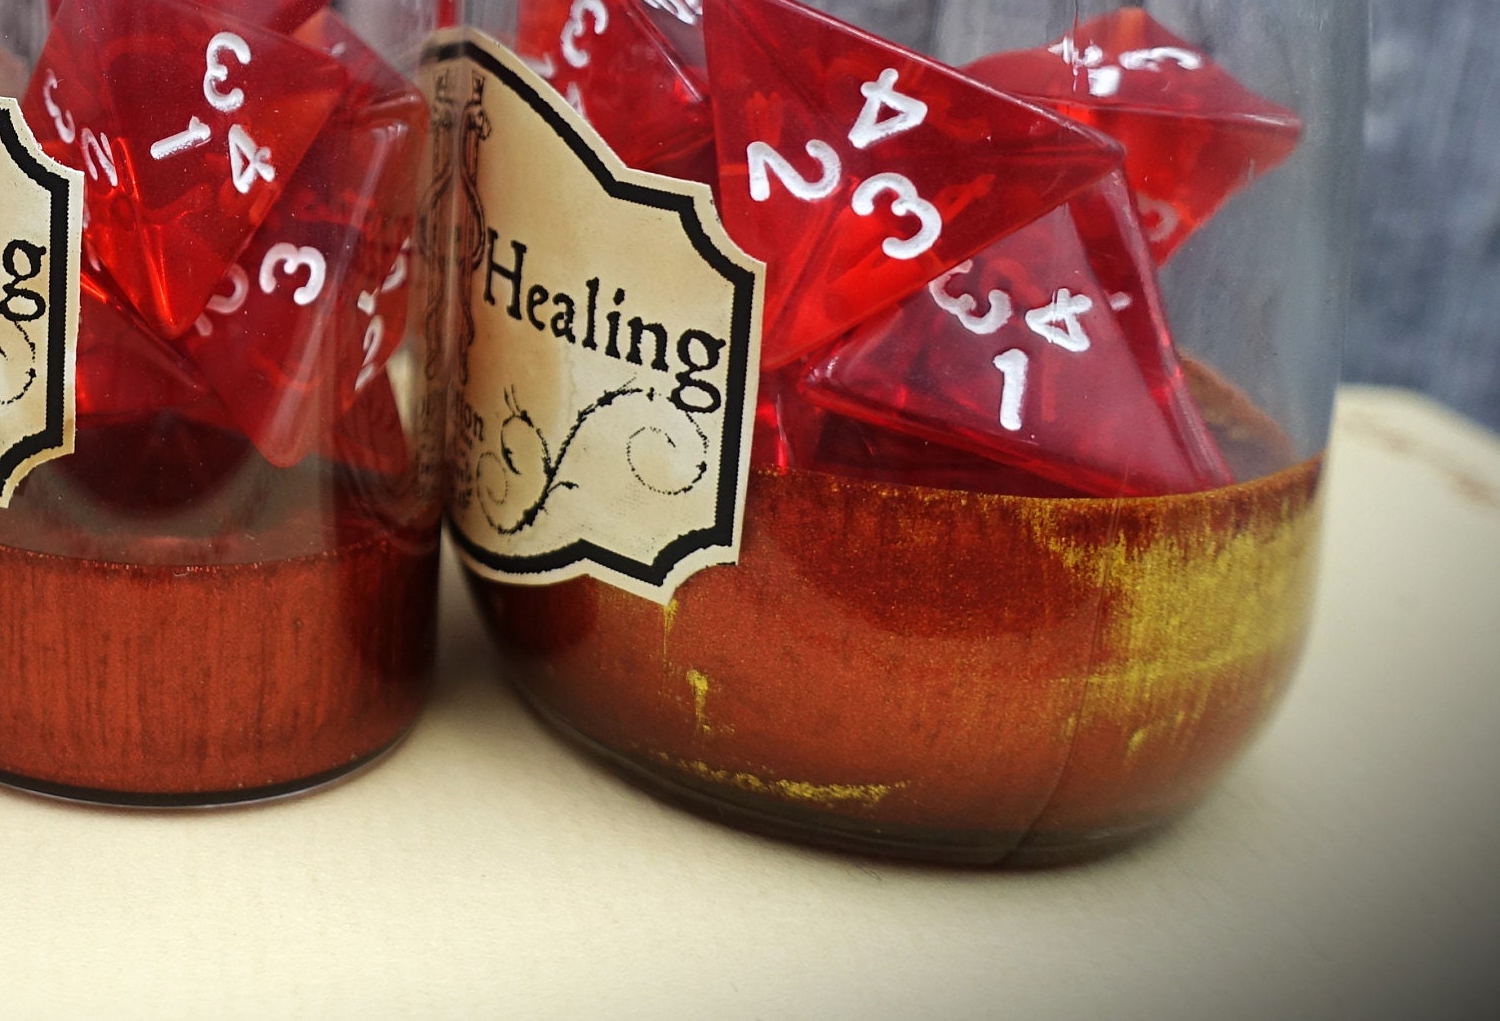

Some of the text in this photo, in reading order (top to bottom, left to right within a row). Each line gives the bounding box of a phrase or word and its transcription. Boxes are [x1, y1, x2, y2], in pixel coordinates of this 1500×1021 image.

[205, 31, 252, 112] 3
[846, 68, 928, 148] 4
[150, 116, 212, 161] 1
[229, 123, 275, 195] 4
[745, 139, 842, 202] 2
[851, 171, 943, 260] 3
[259, 242, 326, 306] 3
[928, 260, 1012, 335] 3
[482, 226, 727, 415] Healing
[1025, 287, 1094, 353] 4
[992, 348, 1028, 431] 1
